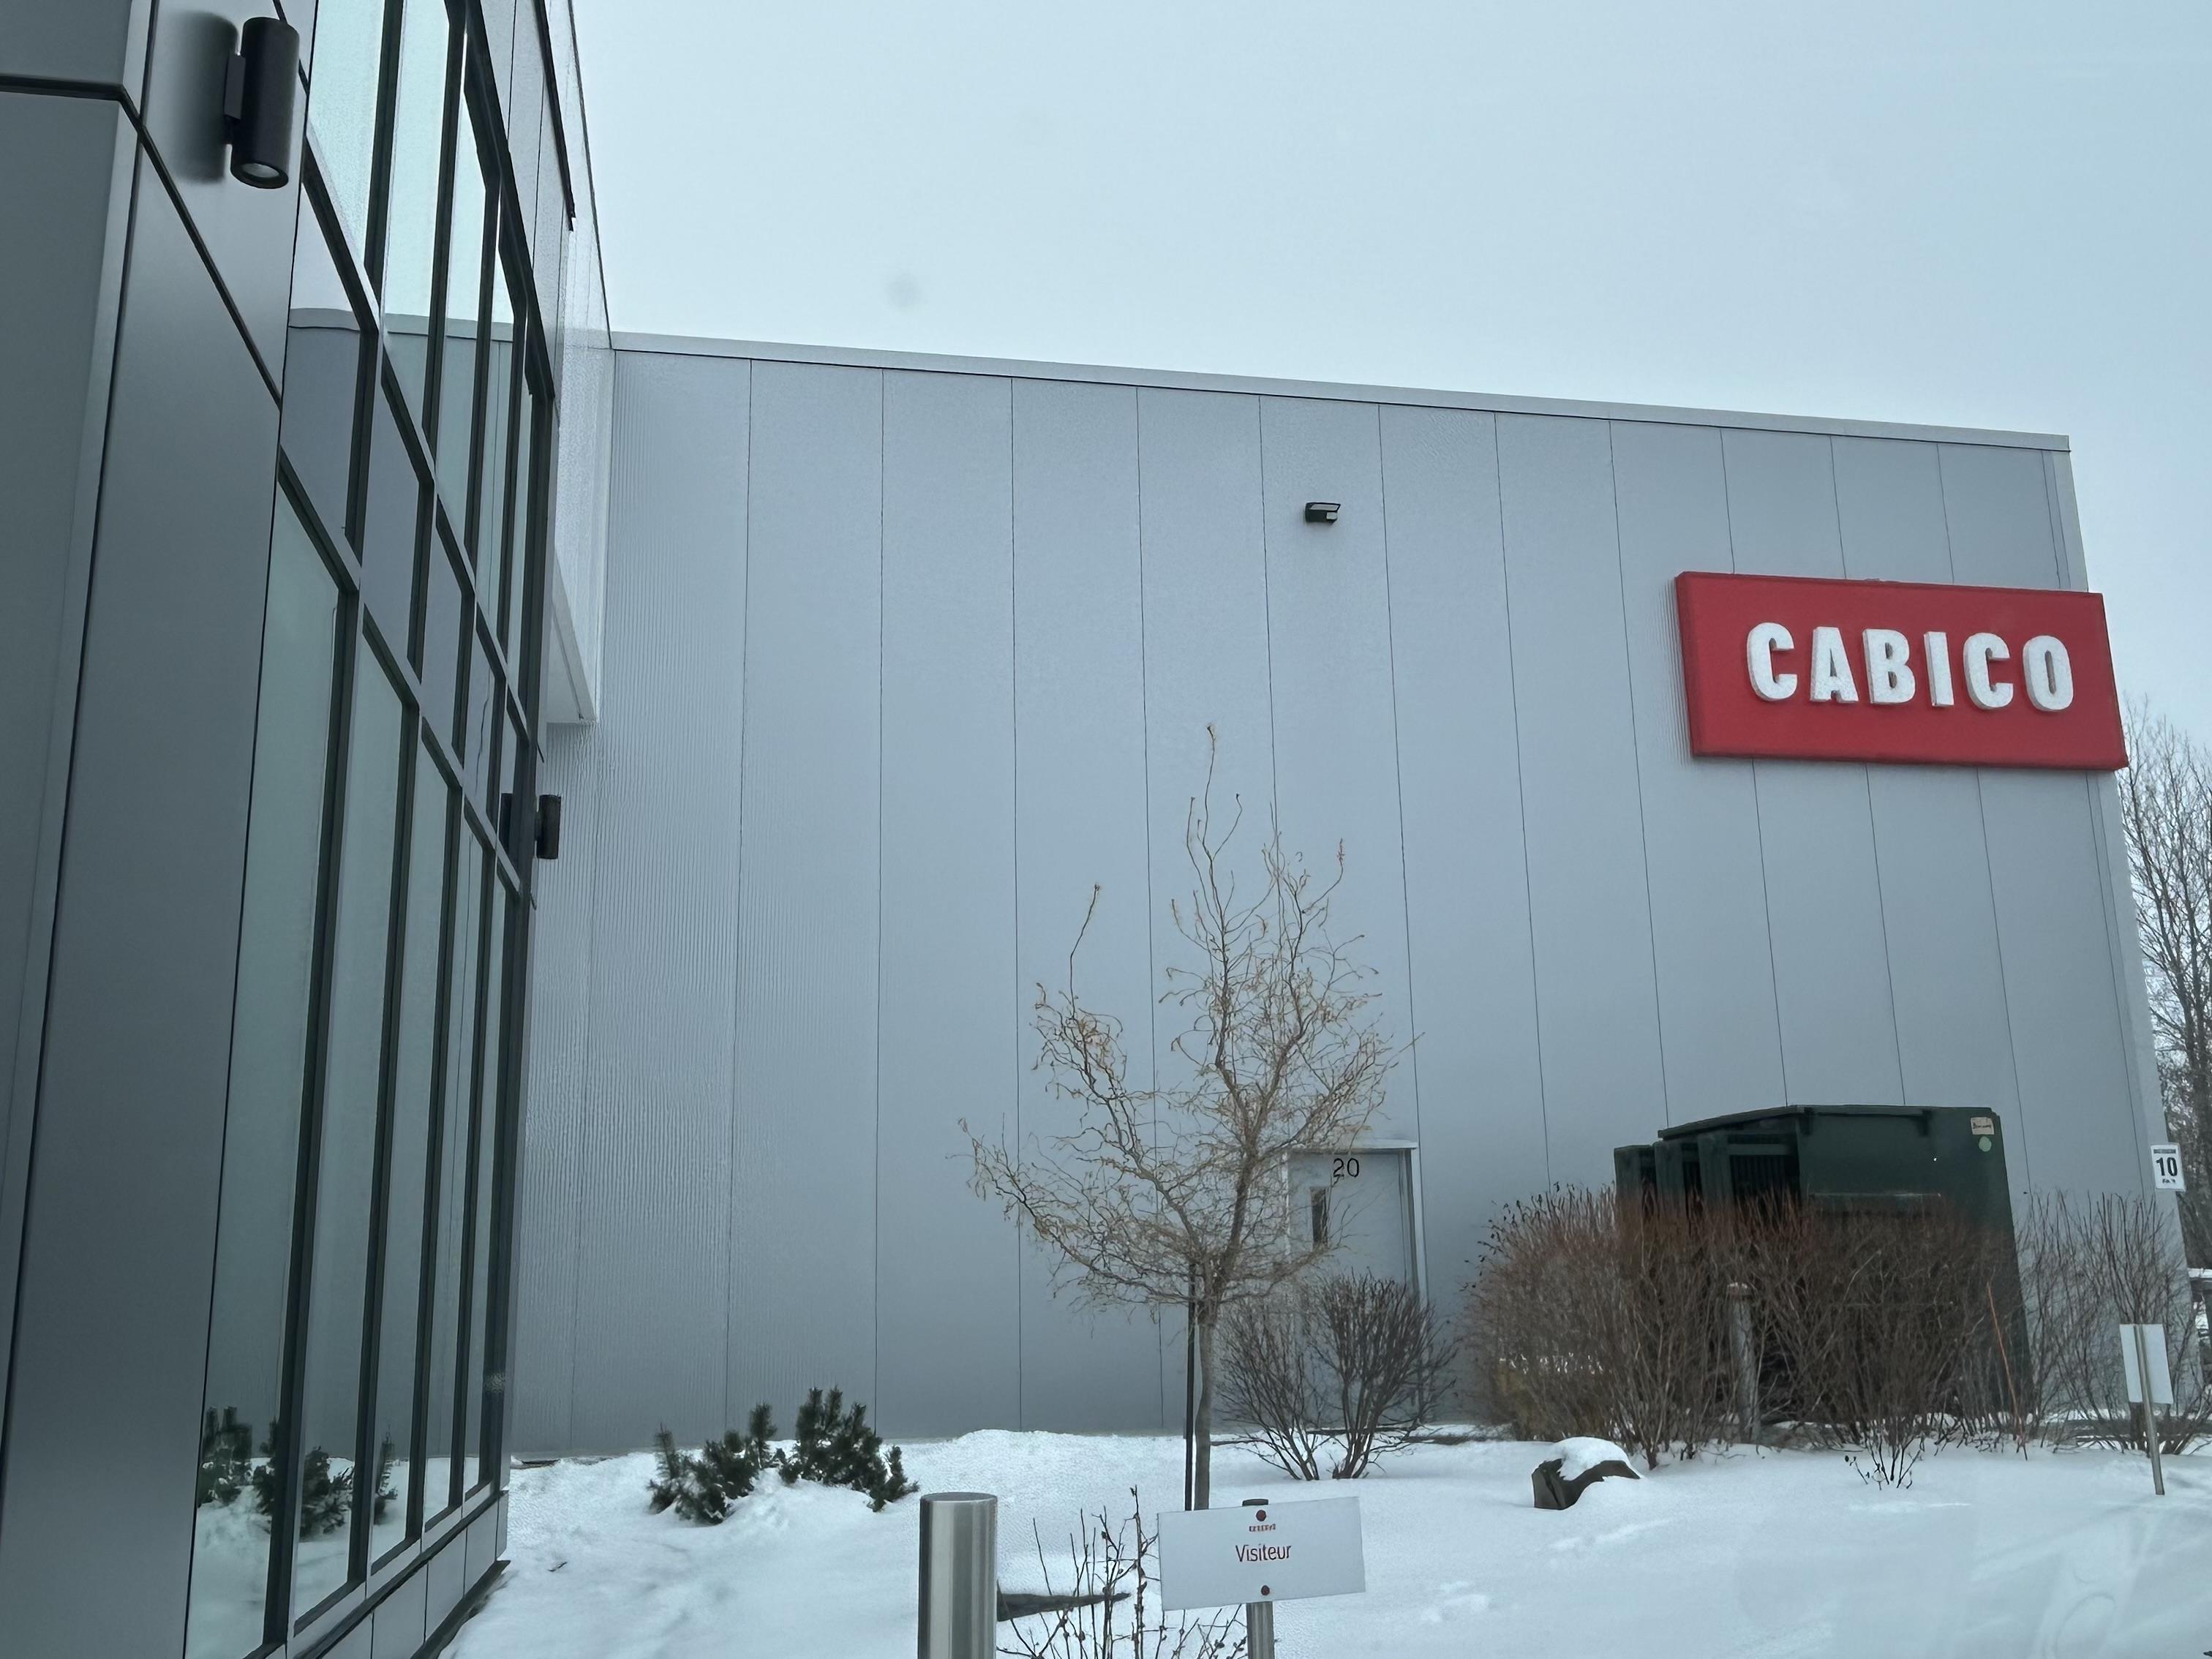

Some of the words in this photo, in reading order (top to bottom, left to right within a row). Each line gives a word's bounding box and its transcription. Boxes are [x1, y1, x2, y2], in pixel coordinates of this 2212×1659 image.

[1746, 621, 2074, 712] CABICO
[1333, 1157, 1360, 1178] 20
[2156, 1157, 2178, 1177] 10
[1235, 1543, 1292, 1562] Visiteur
